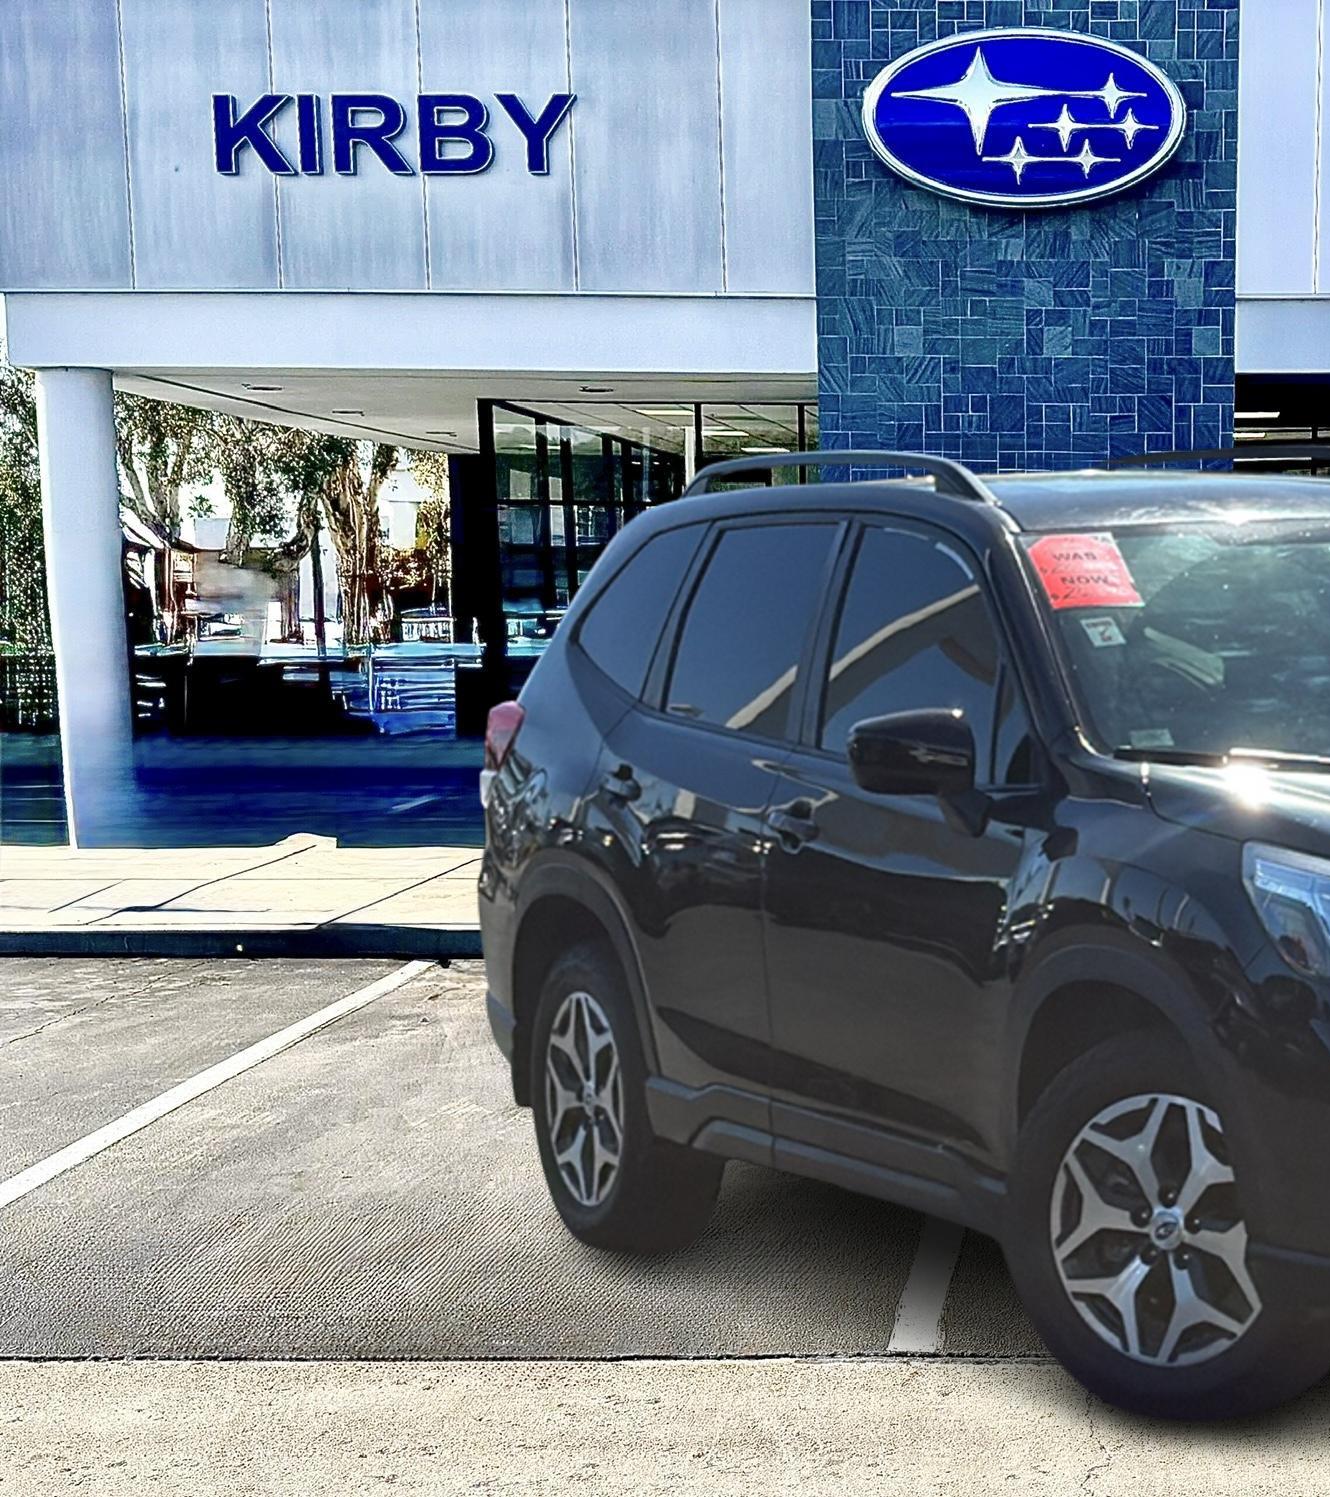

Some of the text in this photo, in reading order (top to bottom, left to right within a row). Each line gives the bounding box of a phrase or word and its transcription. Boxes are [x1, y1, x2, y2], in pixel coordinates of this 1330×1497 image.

[212, 93, 577, 176] KIRBY
[1053, 552, 1097, 561] WAS
[1060, 575, 1110, 585] NOW
